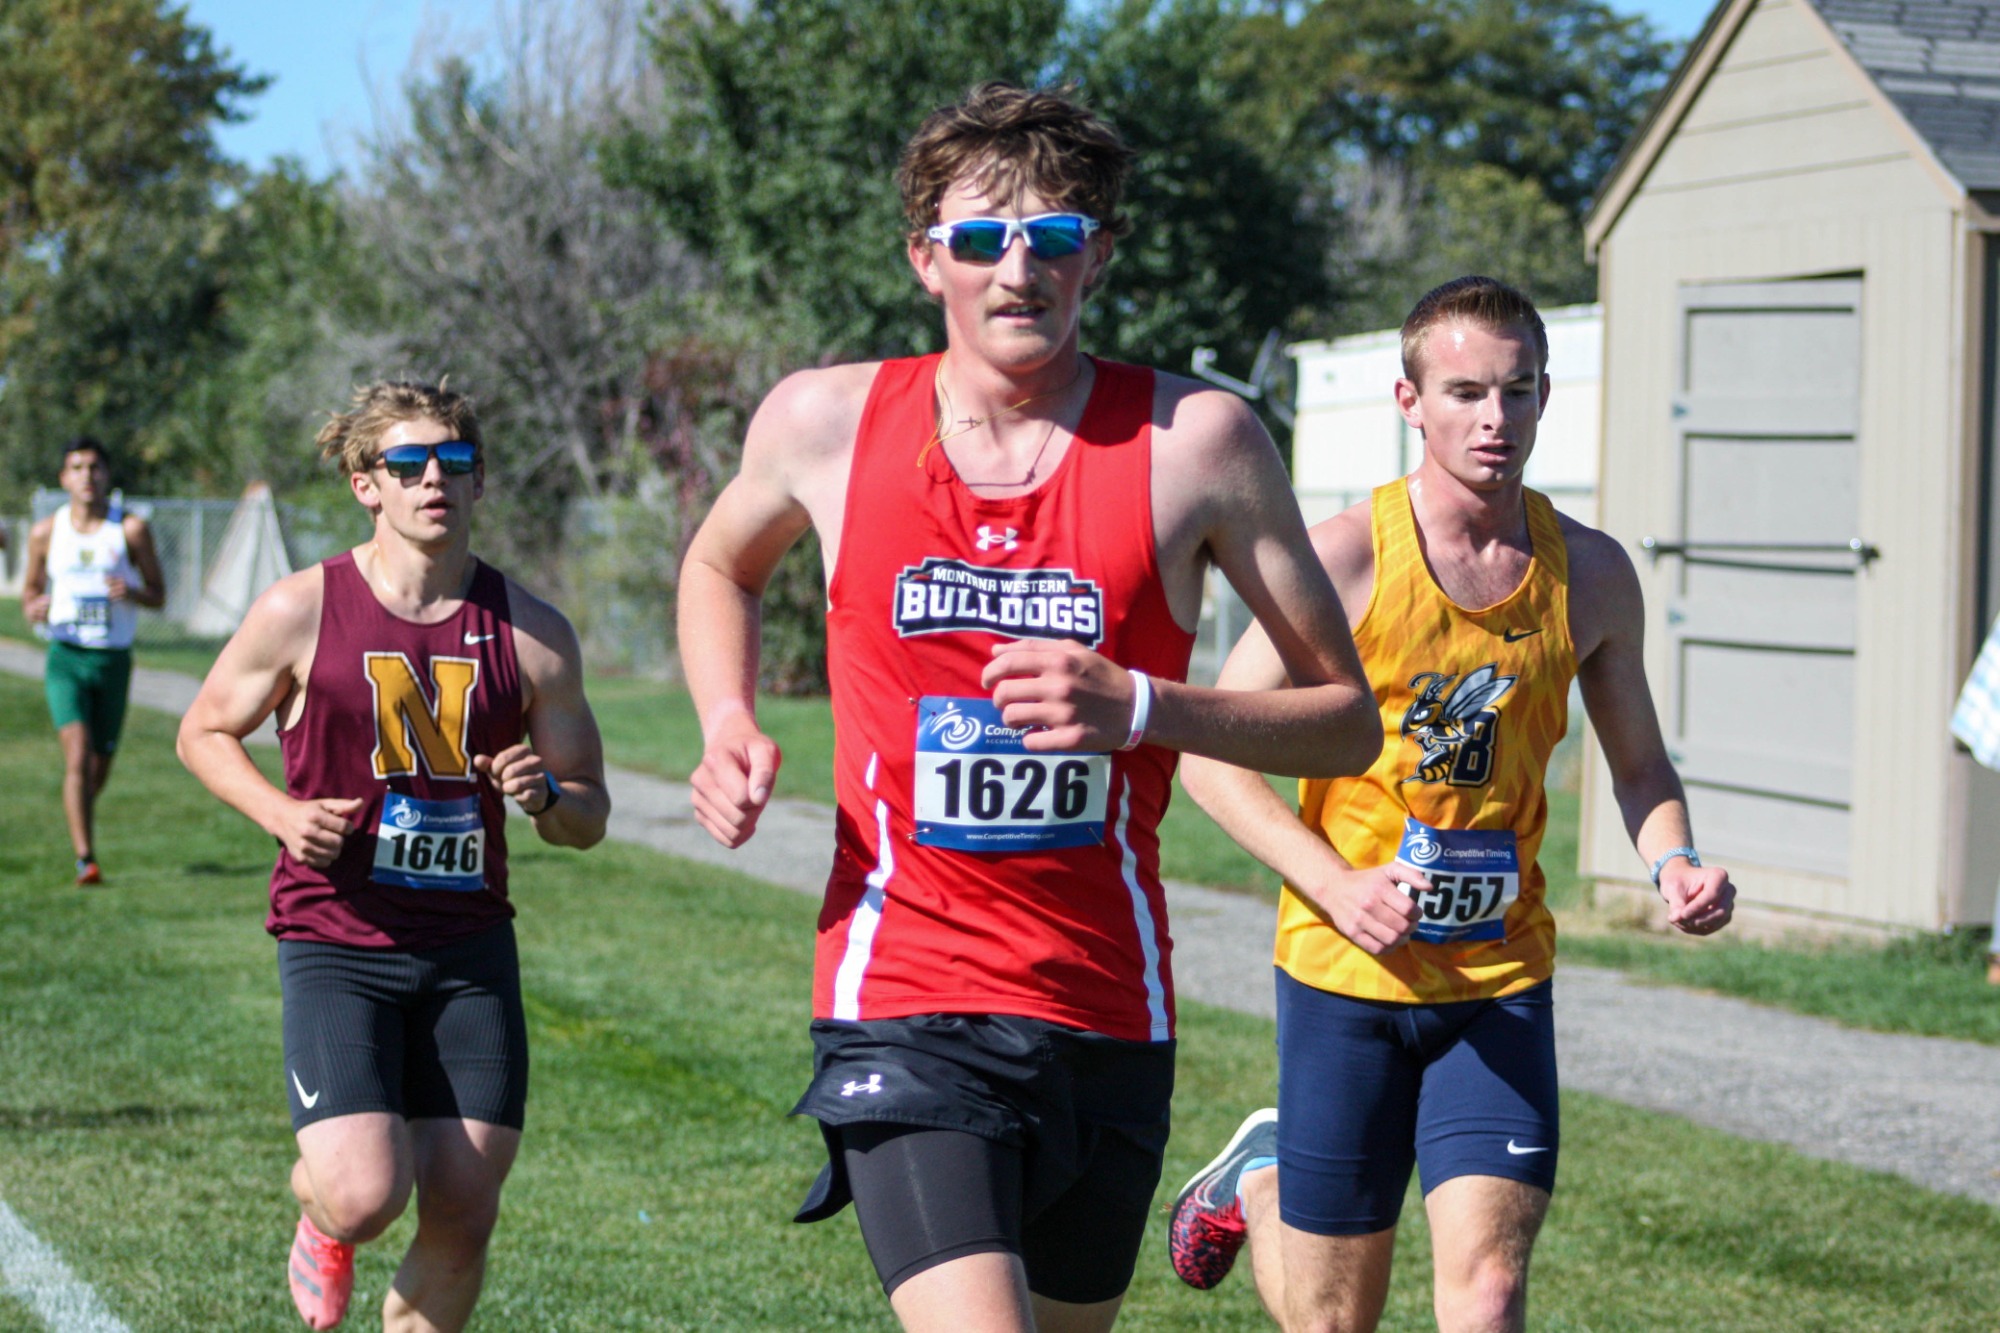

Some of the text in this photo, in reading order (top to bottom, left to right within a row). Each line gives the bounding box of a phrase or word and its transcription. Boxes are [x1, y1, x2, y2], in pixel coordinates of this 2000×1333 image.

[932, 567, 1067, 594] MONTANA WESTERN
[900, 583, 1097, 634] BULLDOGS
[363, 651, 480, 780] N
[1447, 706, 1502, 788] B
[935, 757, 1090, 821] 1626
[391, 832, 479, 874] 1646
[966, 832, 1055, 841] www.CompetitiveTiming.com
[1485, 848, 1511, 860] Timing
